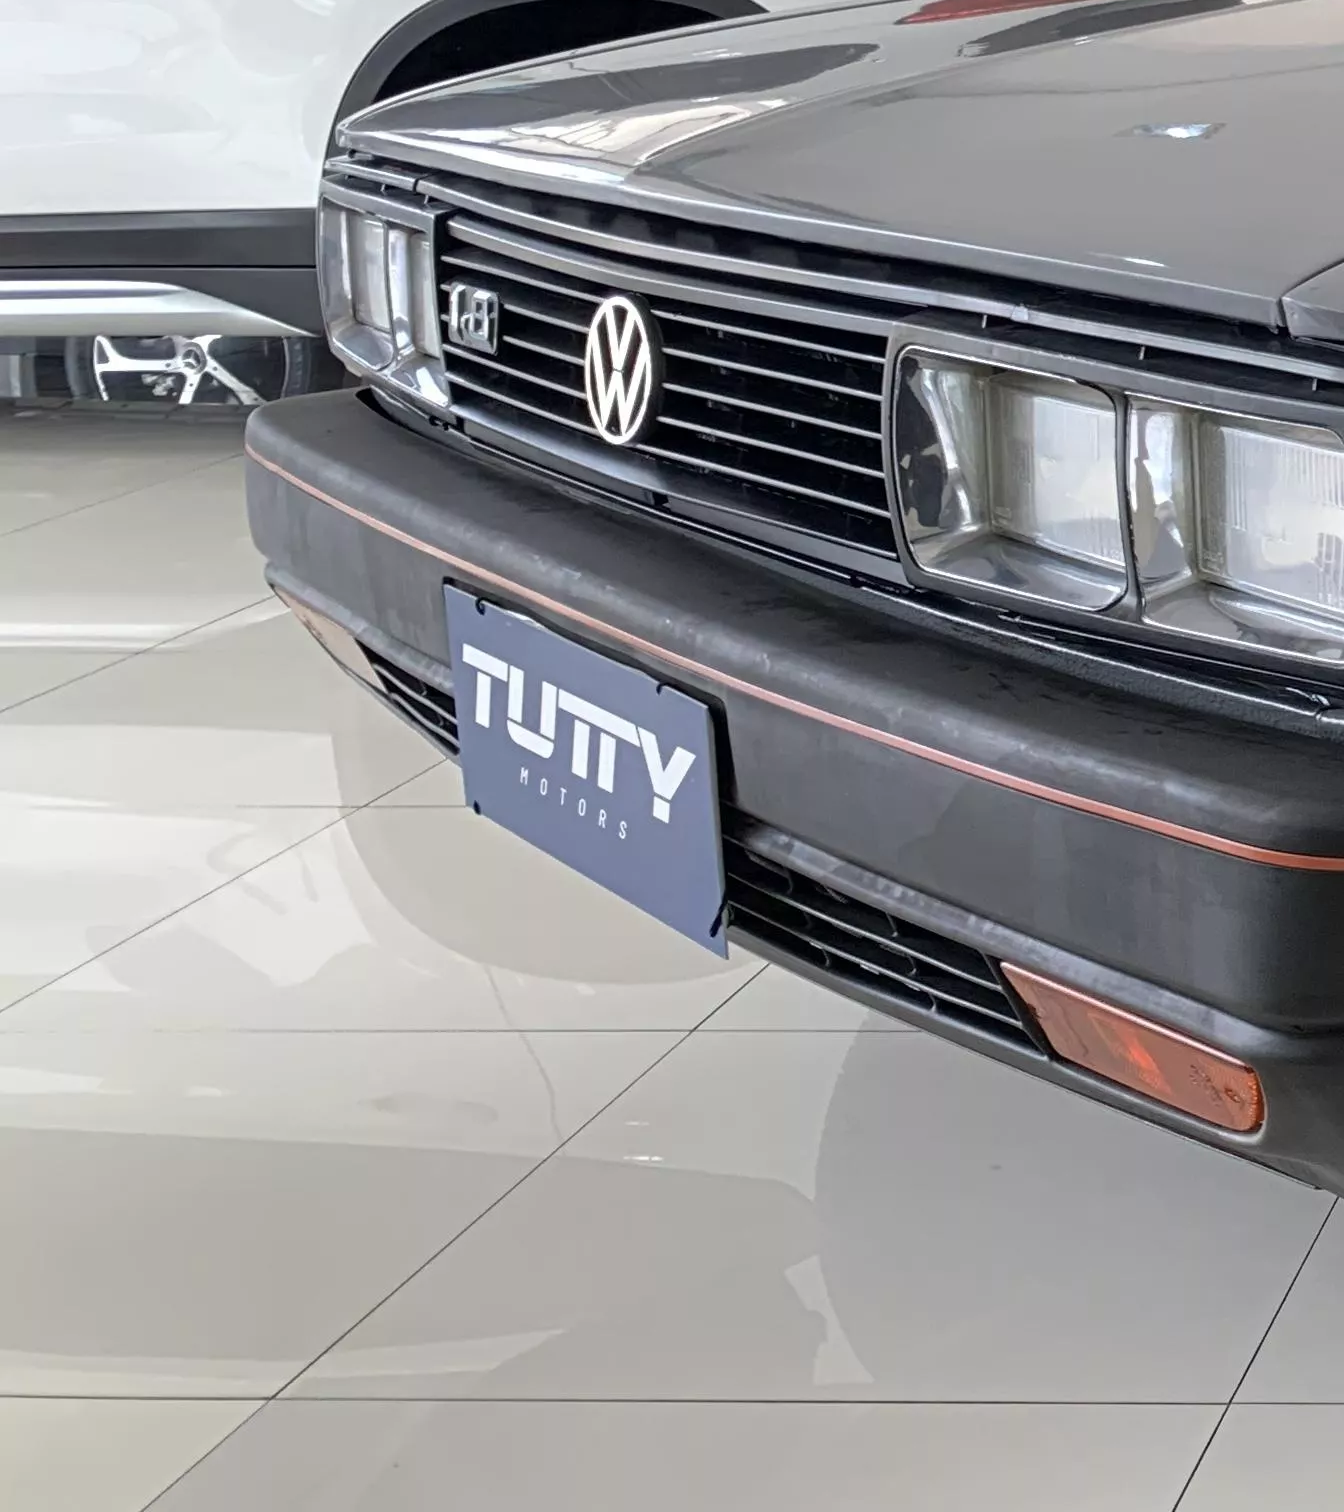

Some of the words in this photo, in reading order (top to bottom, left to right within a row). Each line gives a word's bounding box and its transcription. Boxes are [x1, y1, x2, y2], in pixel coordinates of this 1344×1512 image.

[585, 296, 652, 445] VW
[462, 643, 696, 824] TUTTY
[520, 767, 628, 840] MOTORS
